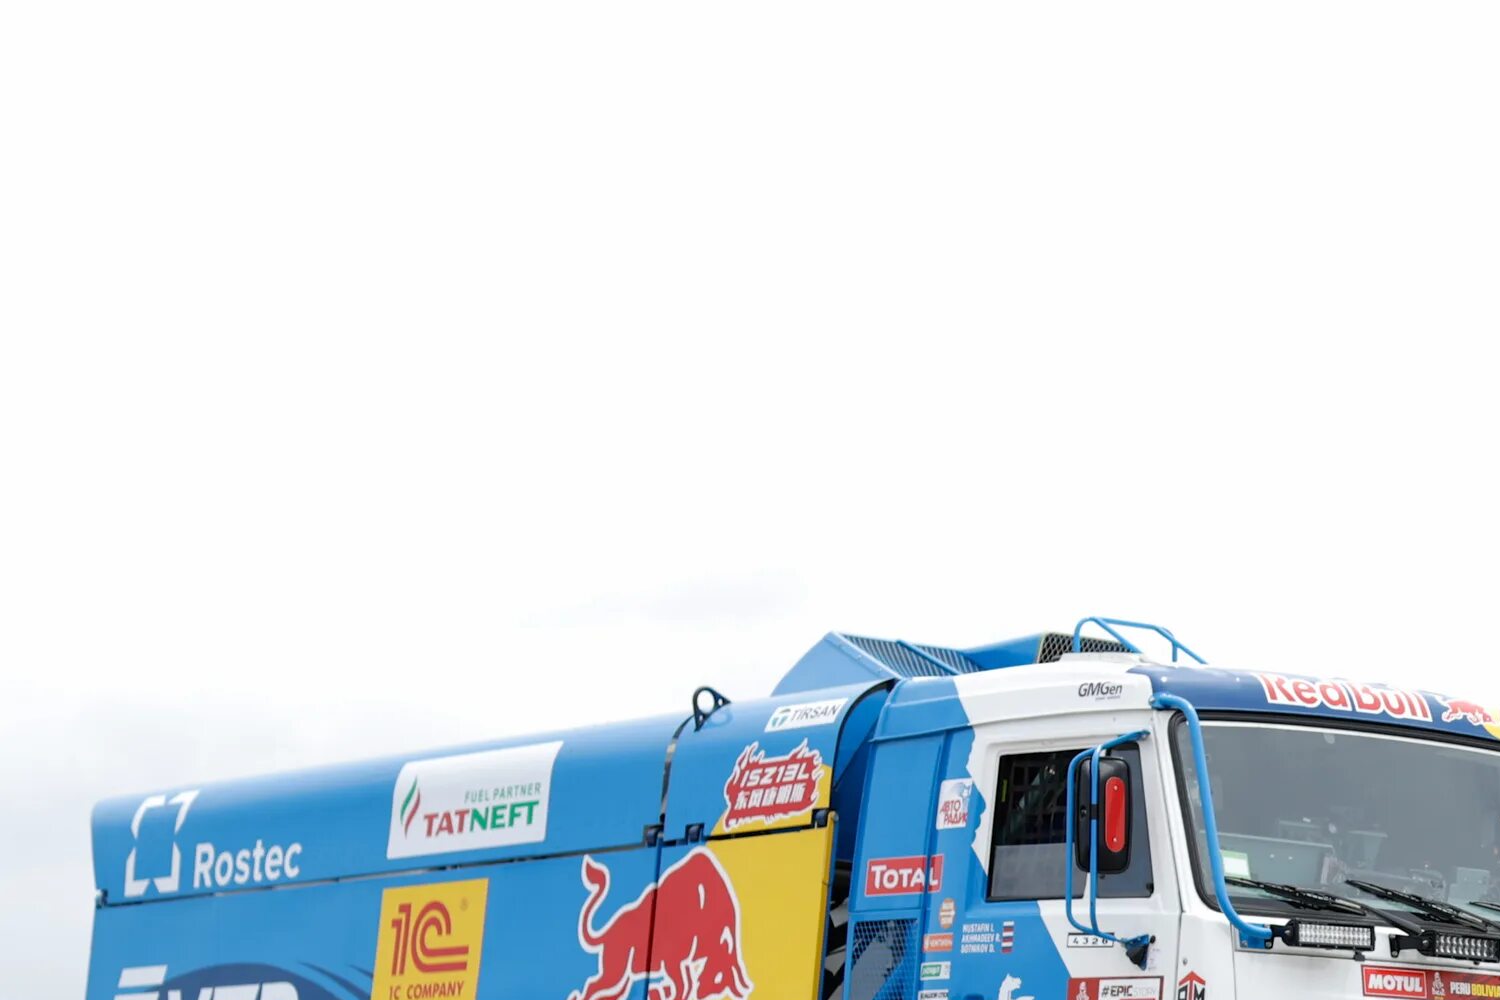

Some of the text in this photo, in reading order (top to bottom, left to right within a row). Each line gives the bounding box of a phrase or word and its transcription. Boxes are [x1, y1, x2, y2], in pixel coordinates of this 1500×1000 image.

[1078, 682, 1123, 698] GMGen
[1259, 672, 1431, 720] Red Bull
[790, 704, 841, 722] TIRSAN
[464, 782, 541, 803] FUEL PARTNER
[424, 800, 540, 837] TATNEFT
[193, 841, 302, 888] Rostec
[871, 865, 939, 889] TOTAL
[406, 981, 464, 1000] COMPANY
[1368, 974, 1423, 992] MOTUL
[1450, 982, 1471, 995] PERU
